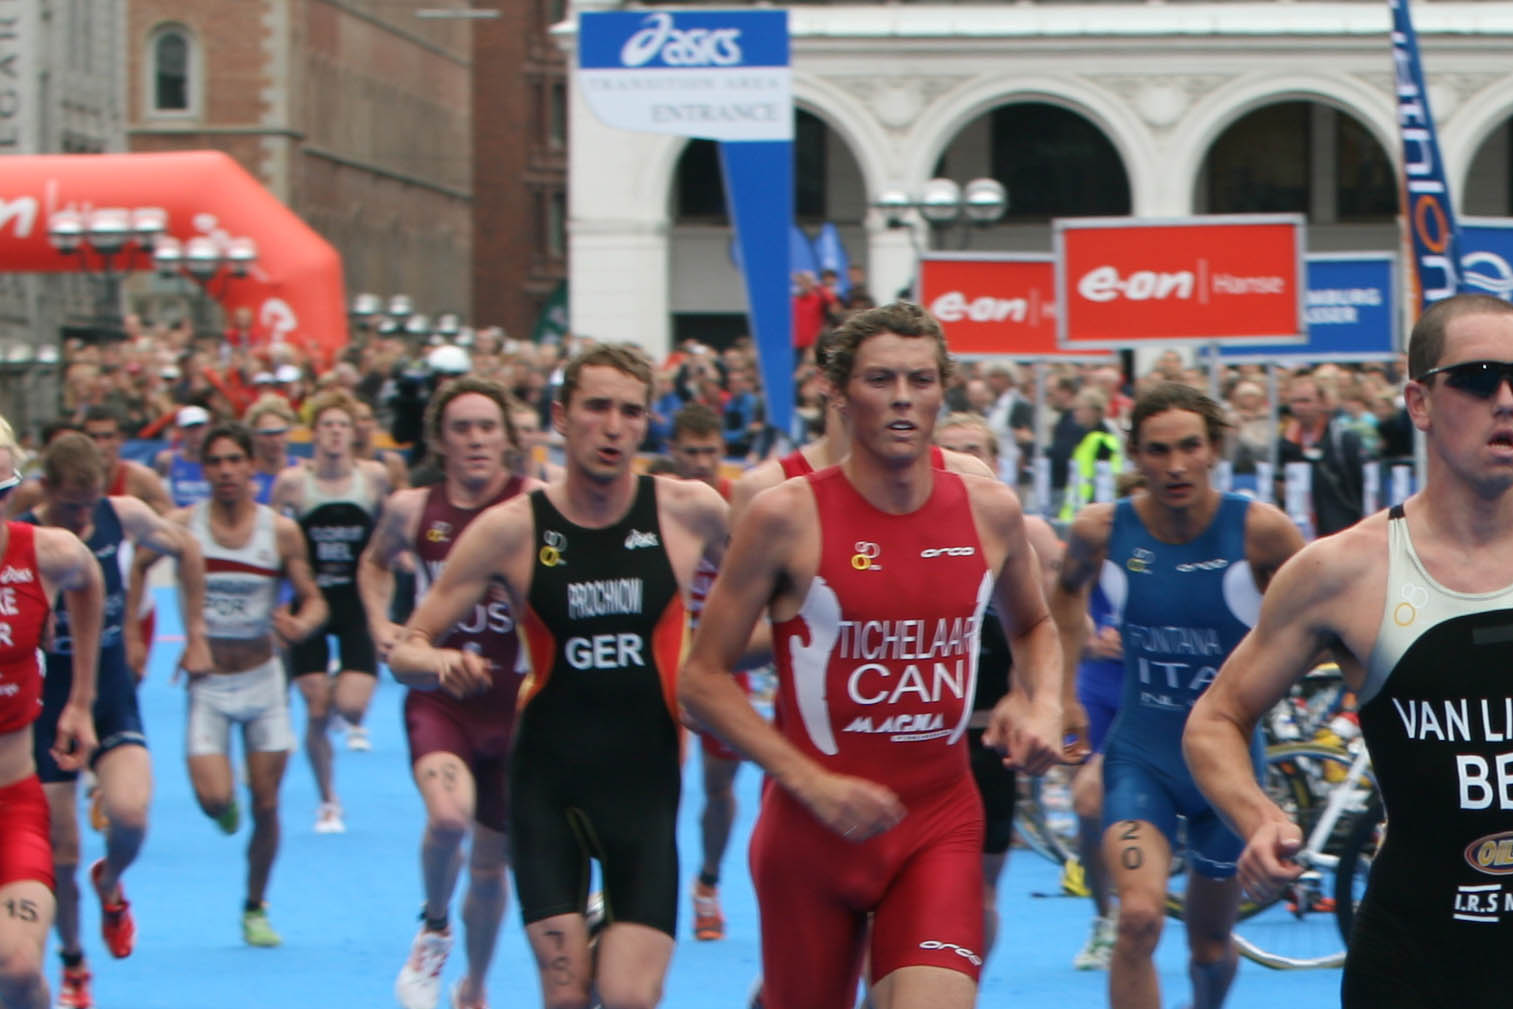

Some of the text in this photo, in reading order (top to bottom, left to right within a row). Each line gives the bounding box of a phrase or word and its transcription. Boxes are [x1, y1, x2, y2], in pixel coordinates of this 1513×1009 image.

[651, 103, 777, 122] ENTRANCE
[1213, 274, 1284, 295] Hanse
[565, 633, 645, 670] GER
[848, 660, 964, 705] CAN
[1392, 697, 1471, 742] VAN
